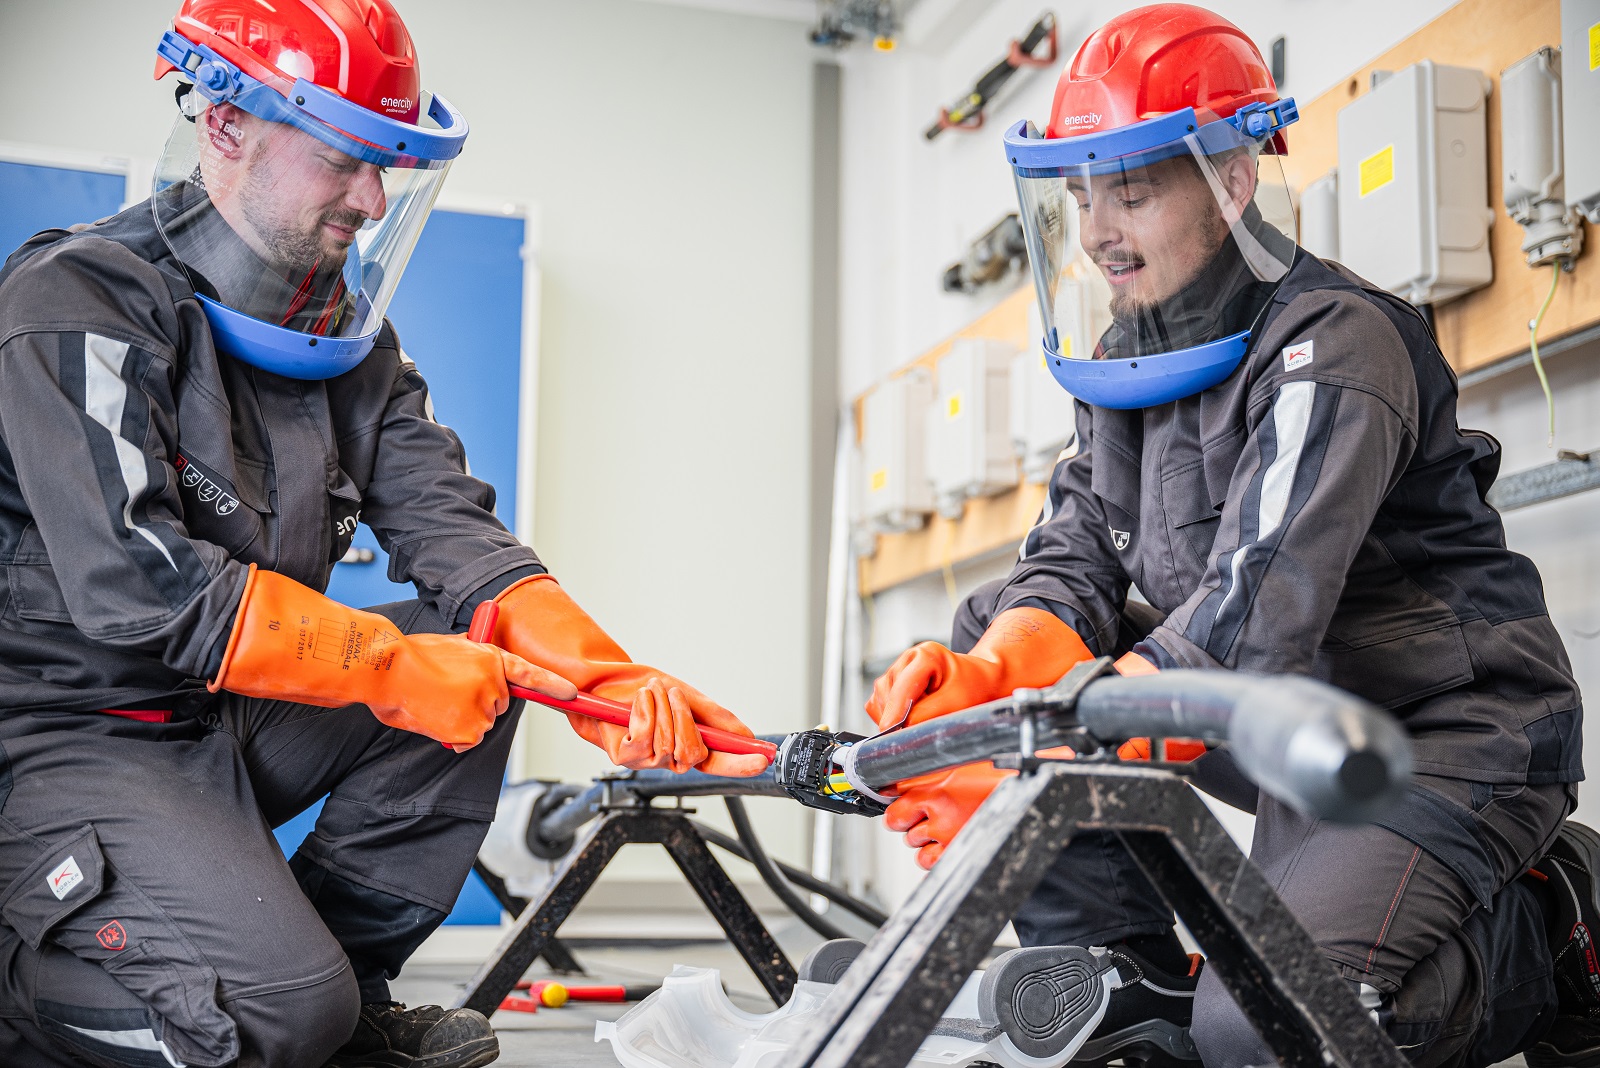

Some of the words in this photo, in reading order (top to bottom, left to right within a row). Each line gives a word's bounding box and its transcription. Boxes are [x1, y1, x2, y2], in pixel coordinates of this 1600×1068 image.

[381, 96, 413, 111] enercity
[1064, 112, 1102, 126] enercity
[223, 122, 245, 140] BSD
[268, 619, 281, 631] 10
[297, 629, 306, 660] 03/2017
[342, 621, 357, 670] CLYDESDALE
